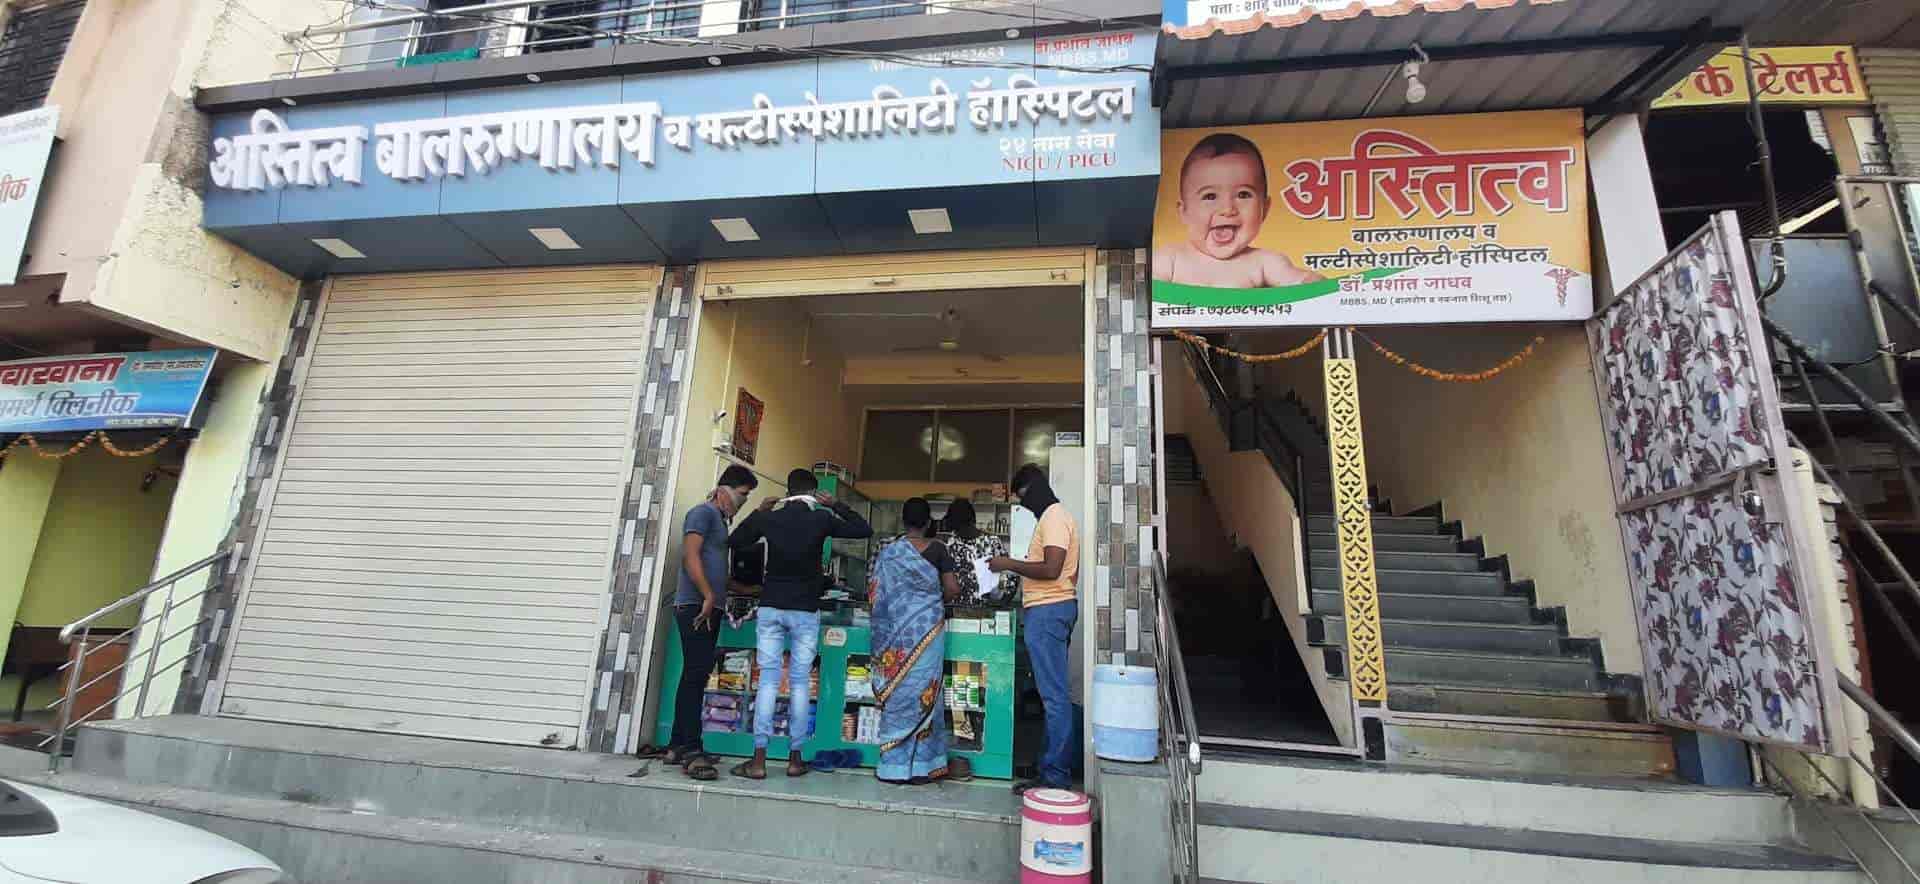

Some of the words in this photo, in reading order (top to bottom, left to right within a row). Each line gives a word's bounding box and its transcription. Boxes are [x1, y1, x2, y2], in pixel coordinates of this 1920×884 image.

[1694, 63, 1734, 97] क
[1752, 51, 1855, 95] टेलर्स
[210, 109, 368, 190] अस्तित्व
[375, 102, 661, 181] बालरुग्णालय
[660, 115, 692, 148] व
[695, 80, 959, 145] मल्टीस्पेशालिटी
[1002, 155, 1050, 171] NICU
[1068, 151, 1117, 169] PICU
[1282, 128, 1576, 221] अस्तित्व
[1482, 224, 1498, 239] व
[1304, 246, 1457, 269] मल्टीस्पेशालिटी
[1459, 243, 1549, 267] हॉस्पिटल
[1340, 275, 1366, 293] डॉ.
[1371, 275, 1418, 291] प्रशांत
[1423, 275, 1473, 290] जाधव
